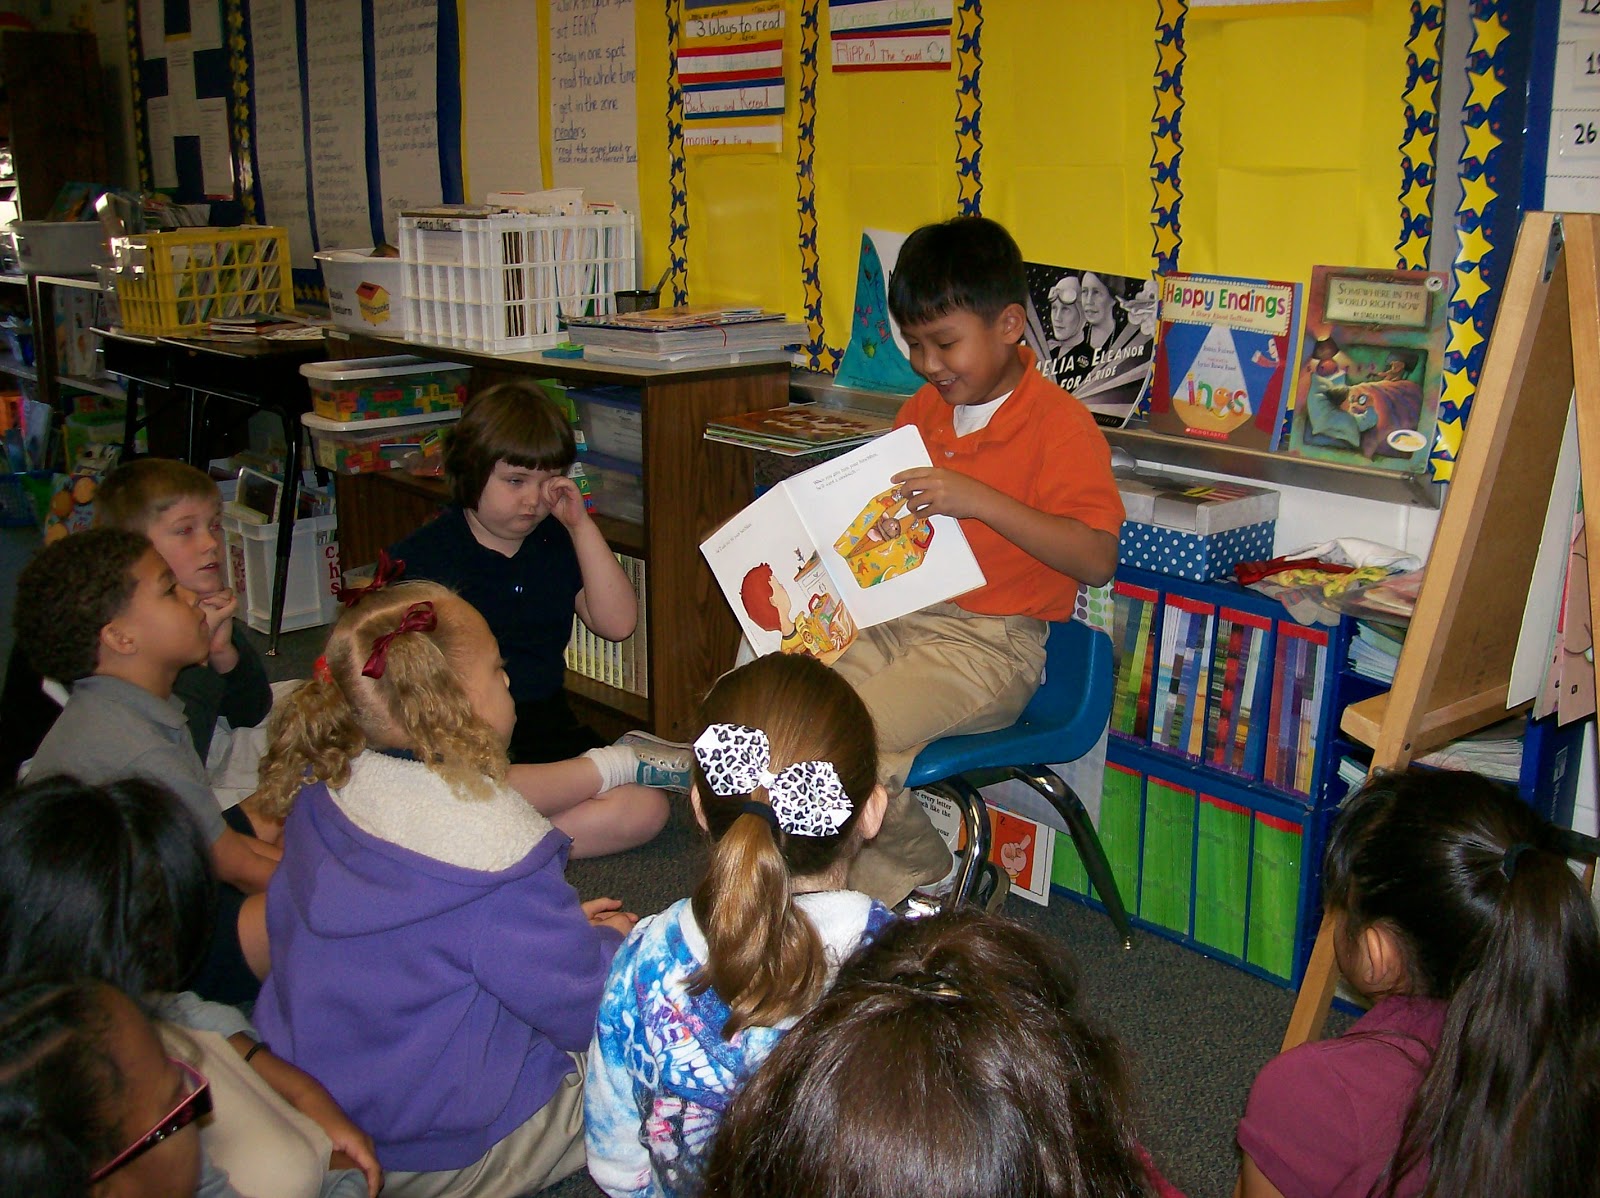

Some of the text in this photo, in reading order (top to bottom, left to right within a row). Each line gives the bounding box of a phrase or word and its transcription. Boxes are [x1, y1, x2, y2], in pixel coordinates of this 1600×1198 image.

[696, 10, 781, 41] 3 Ways to read
[1585, 52, 1600, 75] 1
[560, 68, 577, 88] read
[554, 120, 587, 141] readers
[1574, 122, 1598, 145] 26
[417, 217, 452, 231] data files
[1166, 282, 1286, 319] Happy Endings
[1405, 291, 1421, 300] THE
[1035, 354, 1075, 378] ELIA
[1095, 364, 1118, 381] RIDE
[921, 793, 936, 804] every
[936, 798, 952, 810] letter
[942, 809, 951, 818] the
